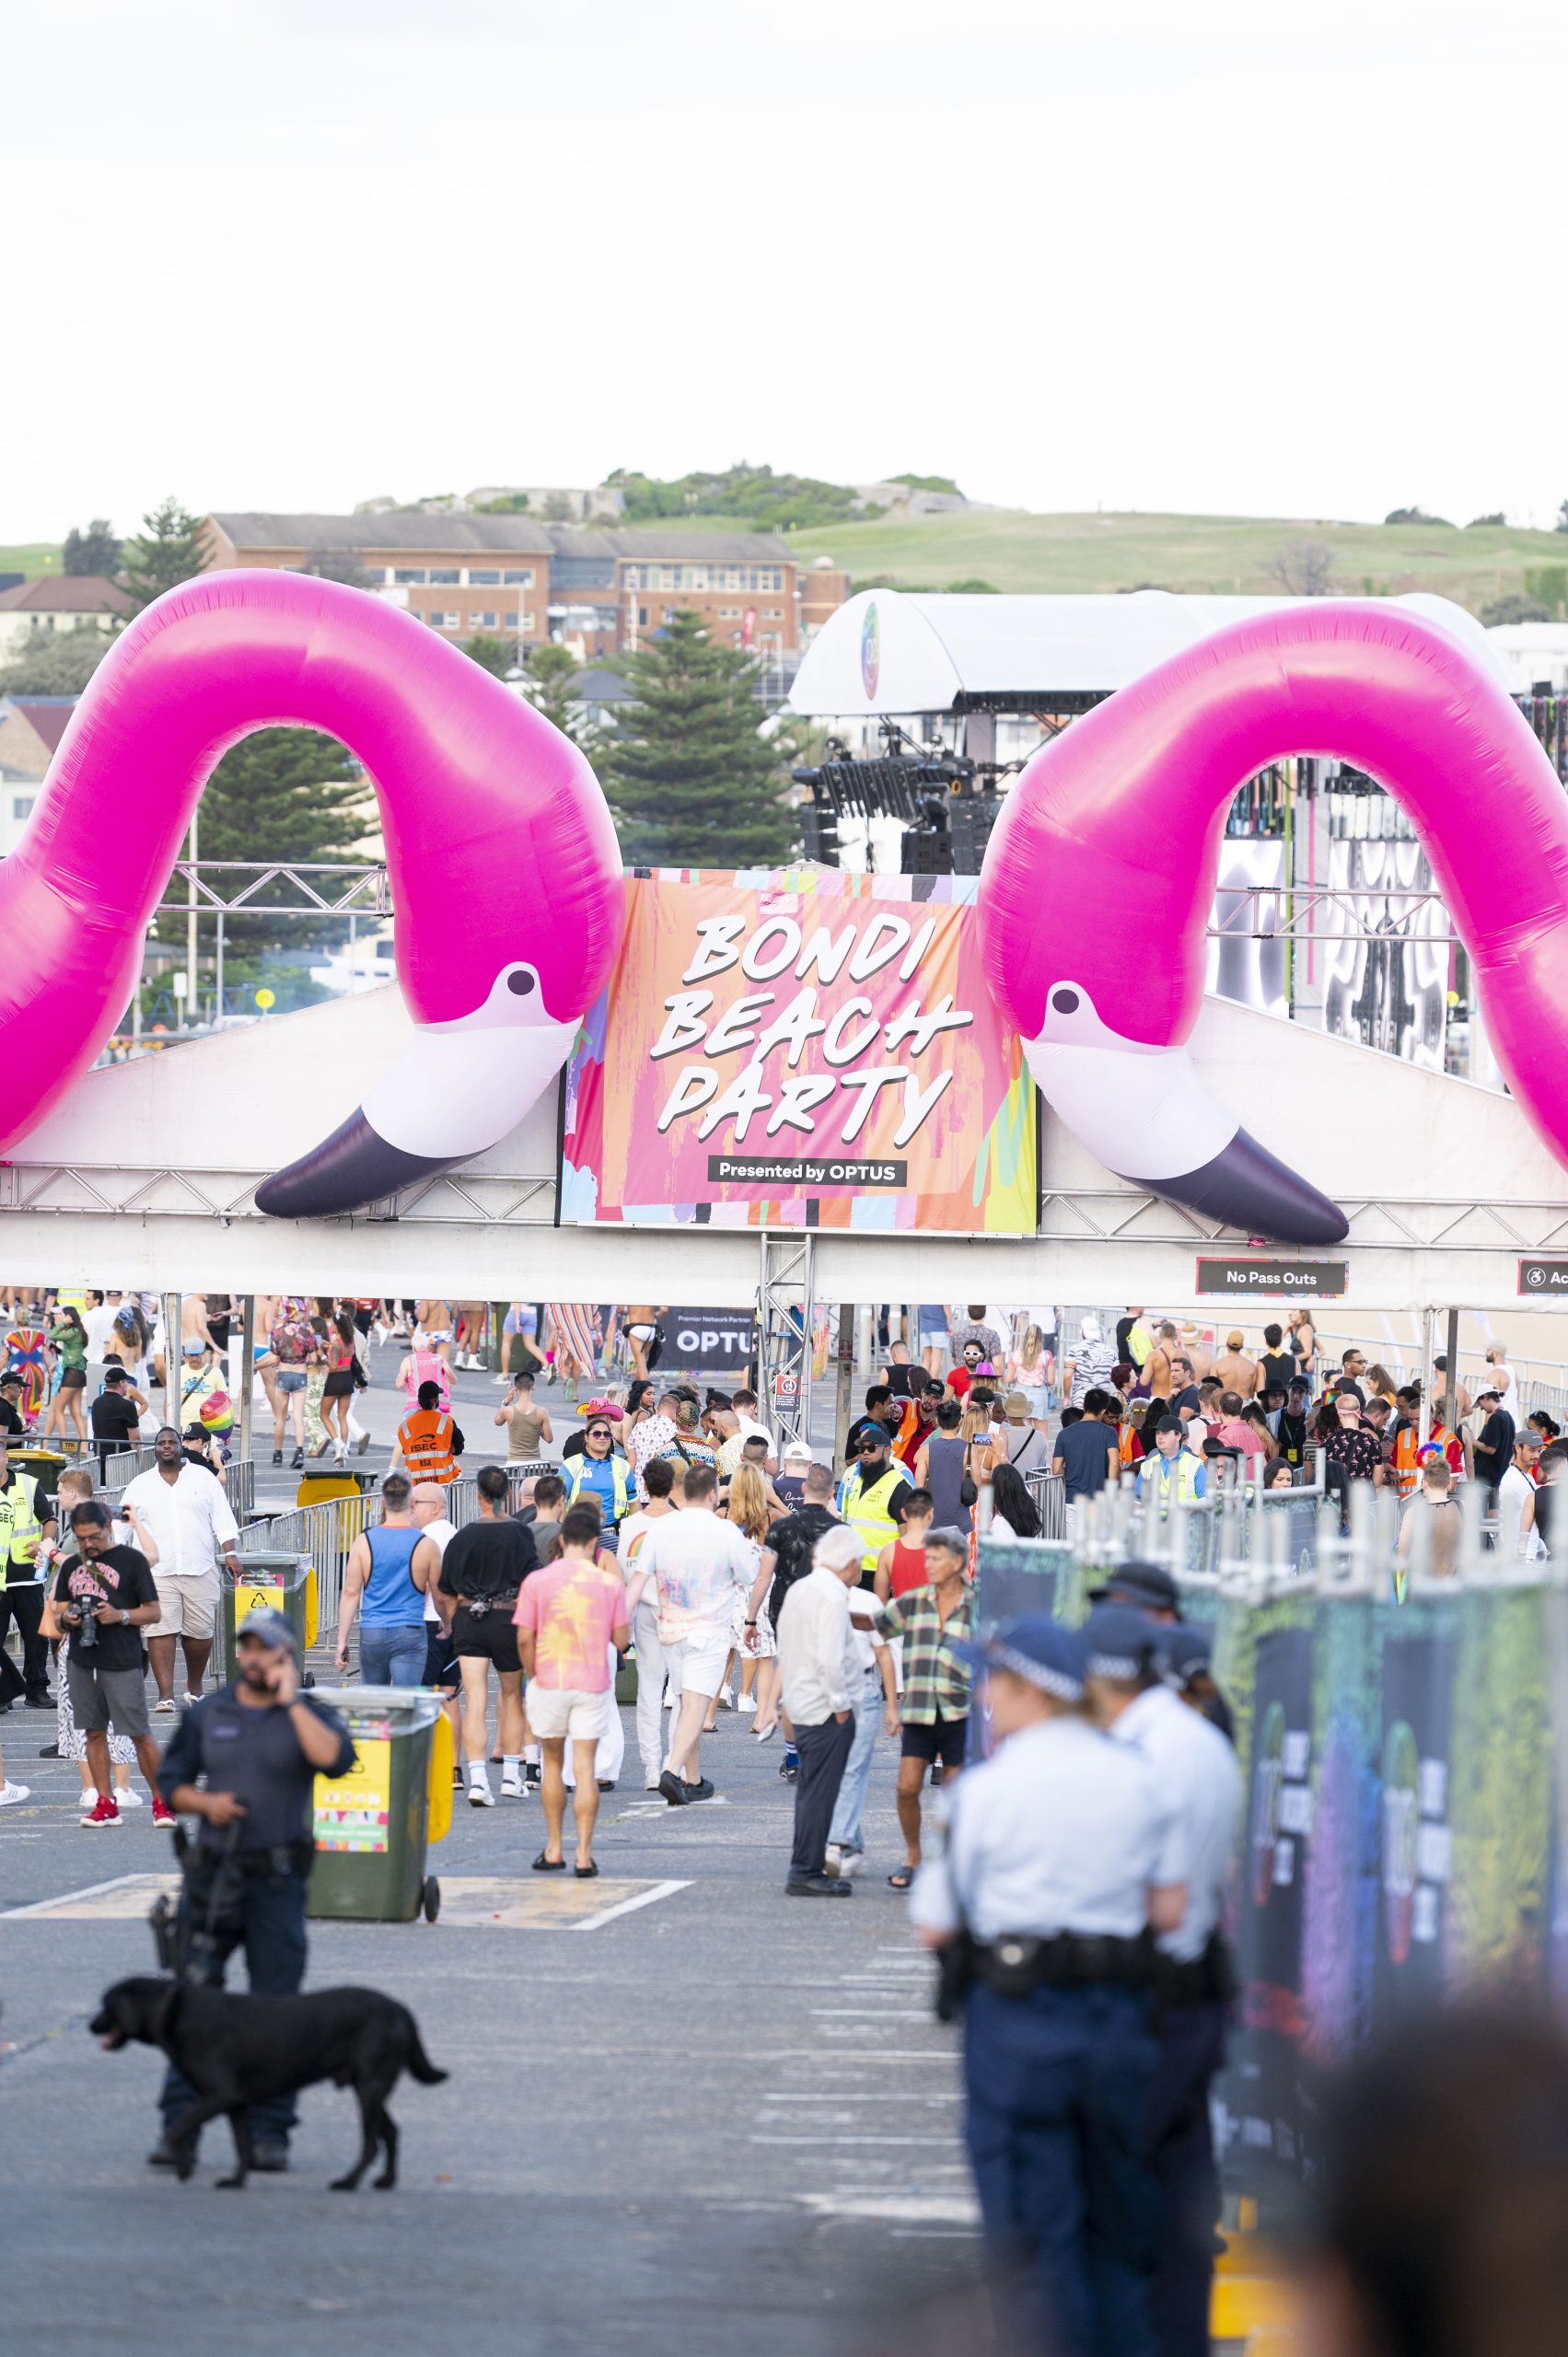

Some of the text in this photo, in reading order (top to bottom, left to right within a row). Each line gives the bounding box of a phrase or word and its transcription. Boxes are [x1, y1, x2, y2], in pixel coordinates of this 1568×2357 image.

[682, 912, 936, 986] BONDI
[650, 986, 973, 1069] BEACH
[656, 1062, 954, 1149] PARTY
[719, 1162, 896, 1182] Presented by OPTUS
[1226, 1271, 1318, 1285] No Pass Outs
[678, 1315, 702, 1323] Premier
[703, 1316, 728, 1324] Network
[677, 1330, 759, 1354] OPTU
[411, 1443, 437, 1453] ISEC
